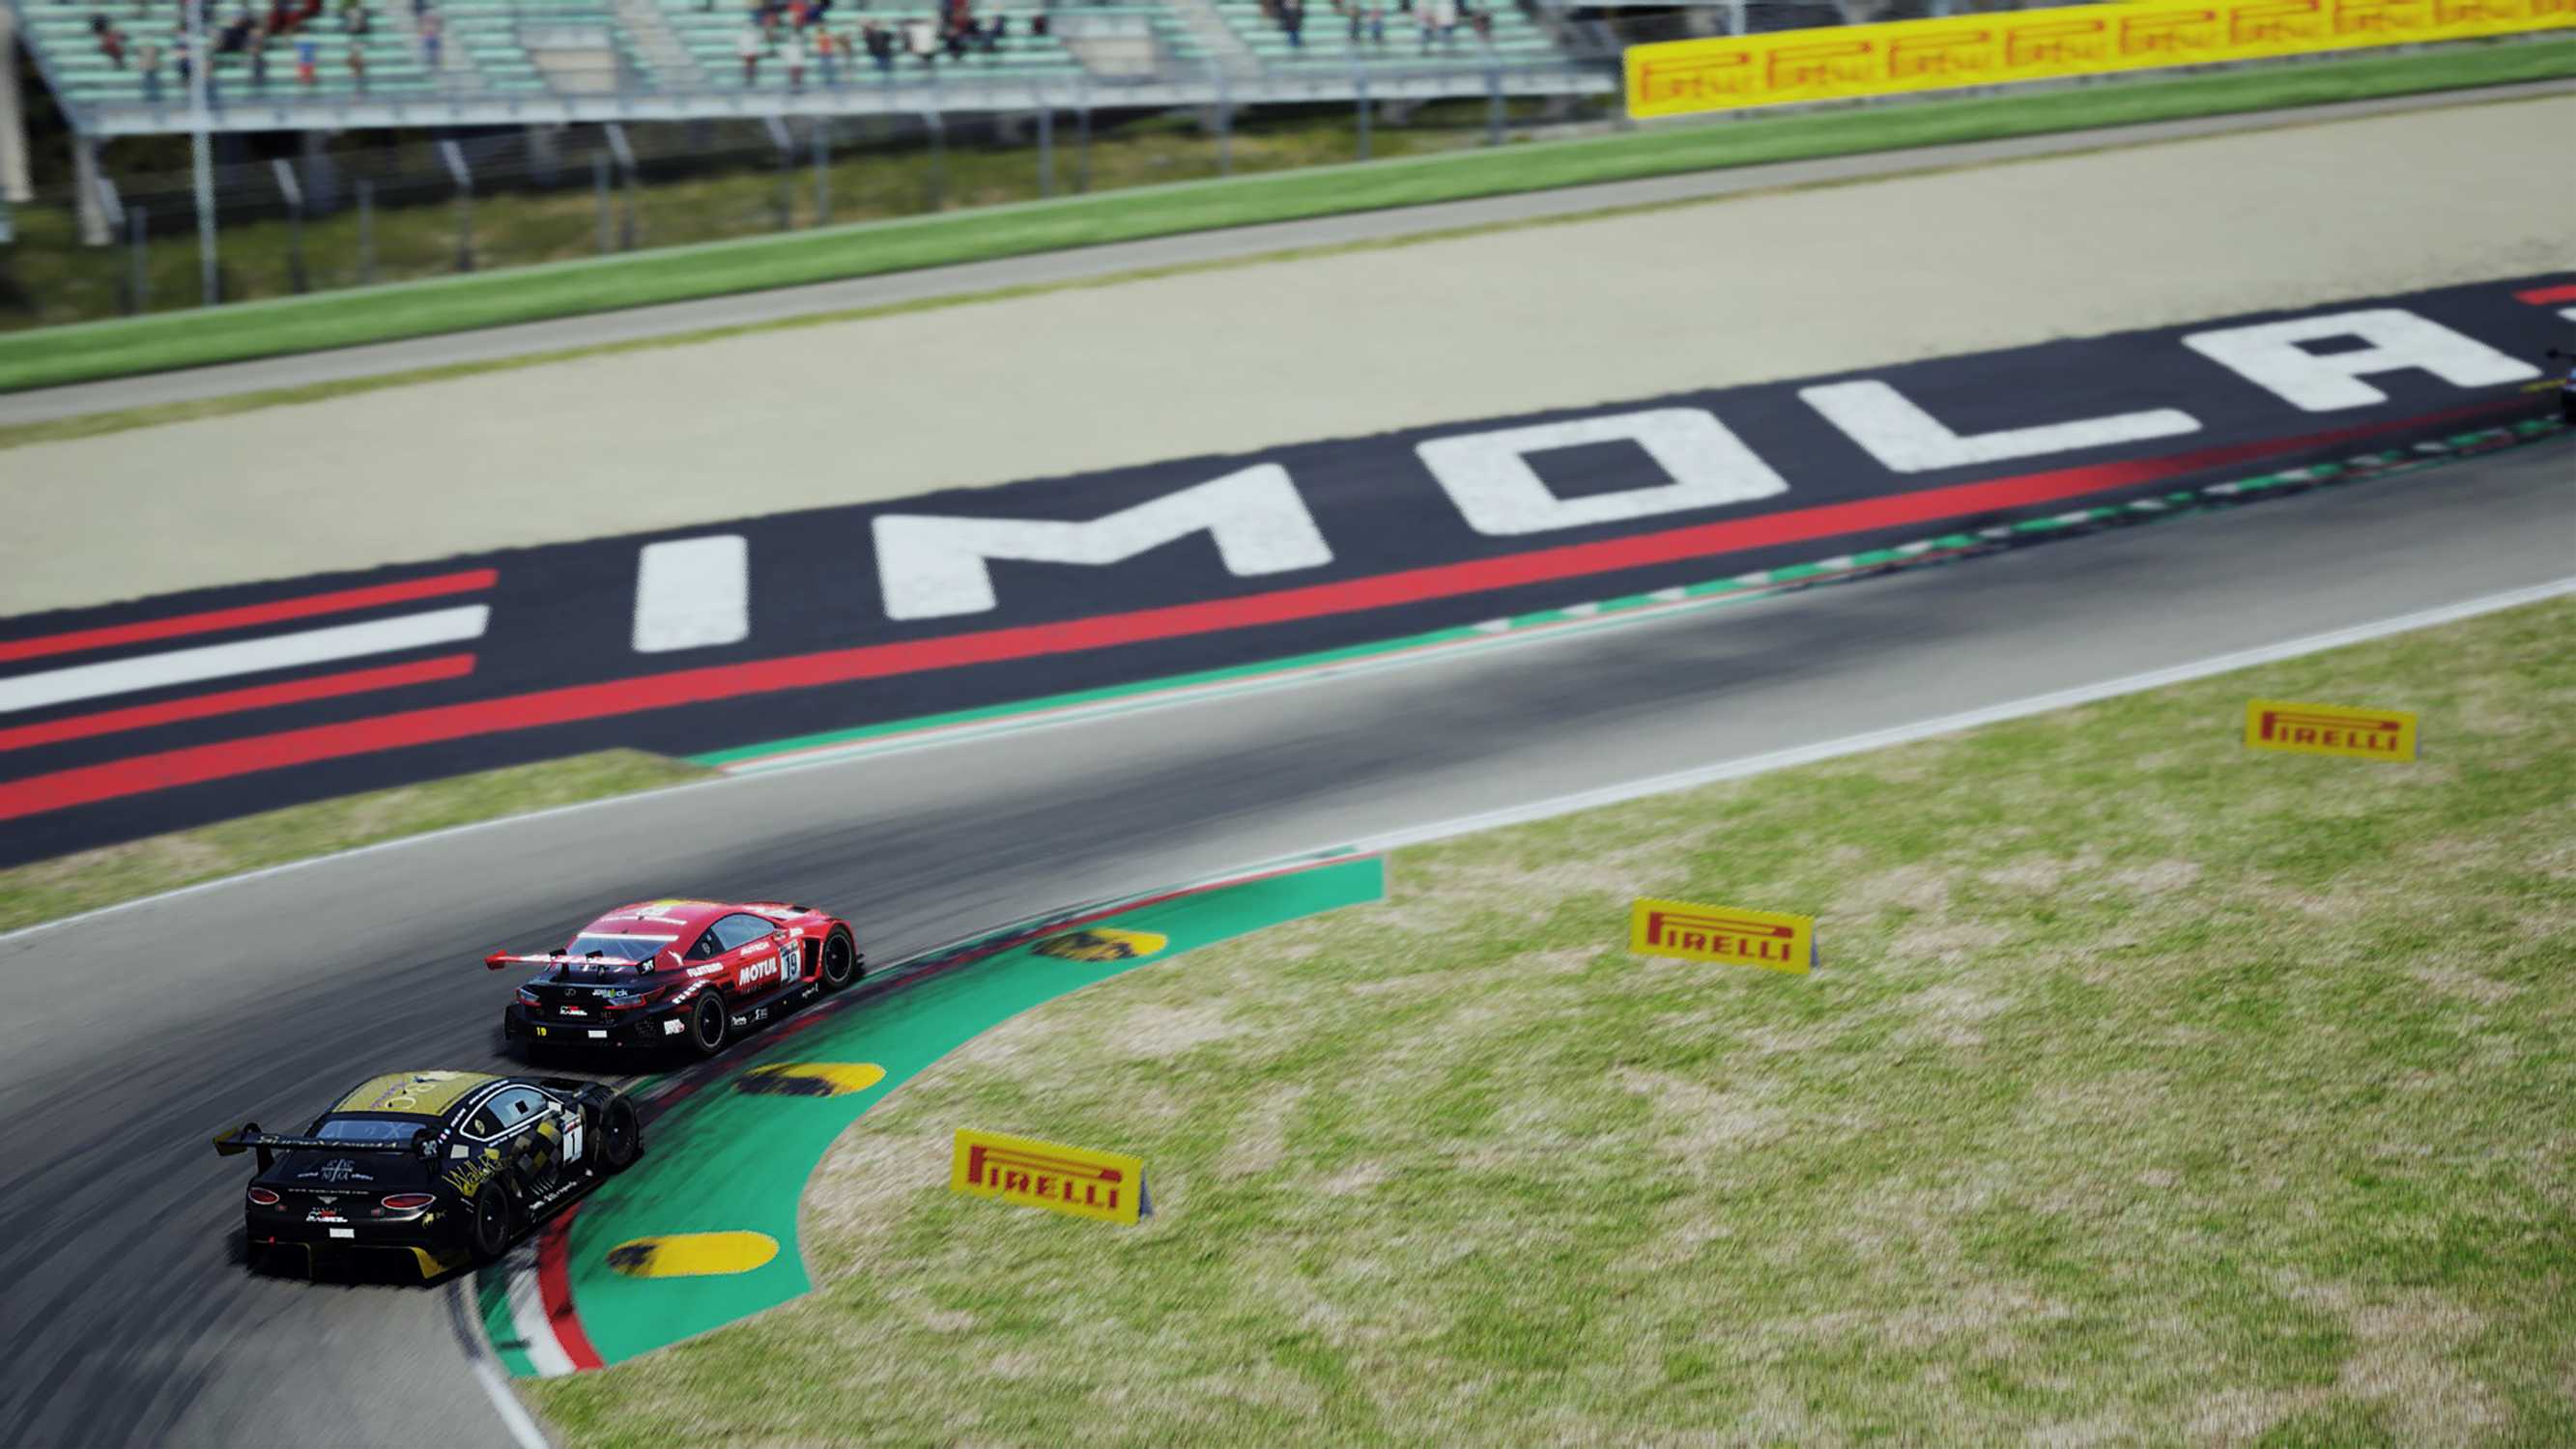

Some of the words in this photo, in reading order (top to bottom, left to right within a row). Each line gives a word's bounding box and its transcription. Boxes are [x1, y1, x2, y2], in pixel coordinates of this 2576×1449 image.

[633, 309, 2543, 653] IMOLA
[2259, 711, 2402, 753] PIRELLI
[1647, 911, 1794, 962] PIRELLI
[738, 956, 777, 986] MOTUL
[786, 952, 797, 978] 19
[967, 1144, 1123, 1211] PIRELLI
